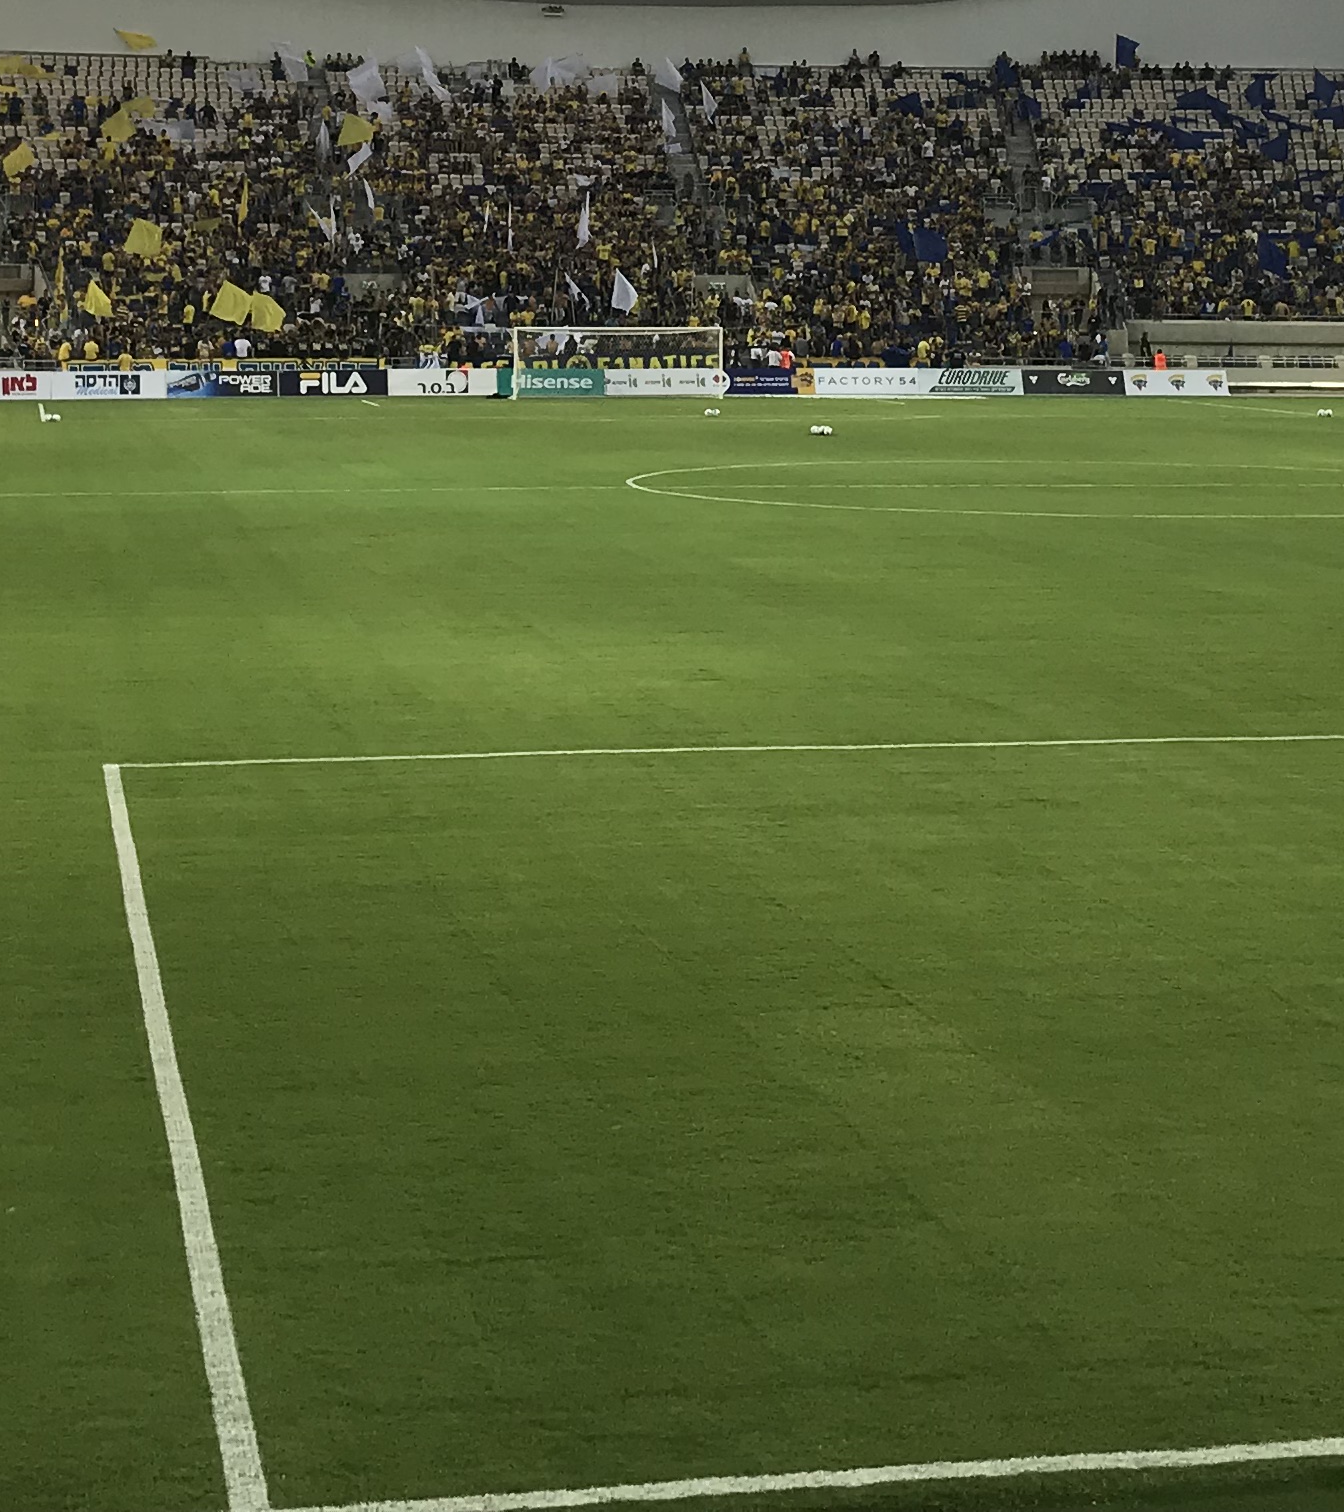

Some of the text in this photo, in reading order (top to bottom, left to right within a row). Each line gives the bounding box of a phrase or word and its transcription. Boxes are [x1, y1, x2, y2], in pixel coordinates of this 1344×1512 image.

[75, 375, 118, 388] הדסה
[219, 375, 272, 384] POWER
[300, 372, 367, 394] FILA
[511, 374, 593, 389] Hisense
[818, 376, 916, 385] FACTORY 54
[938, 368, 1010, 385] EURODRIVE
[2, 374, 37, 396] לאן
